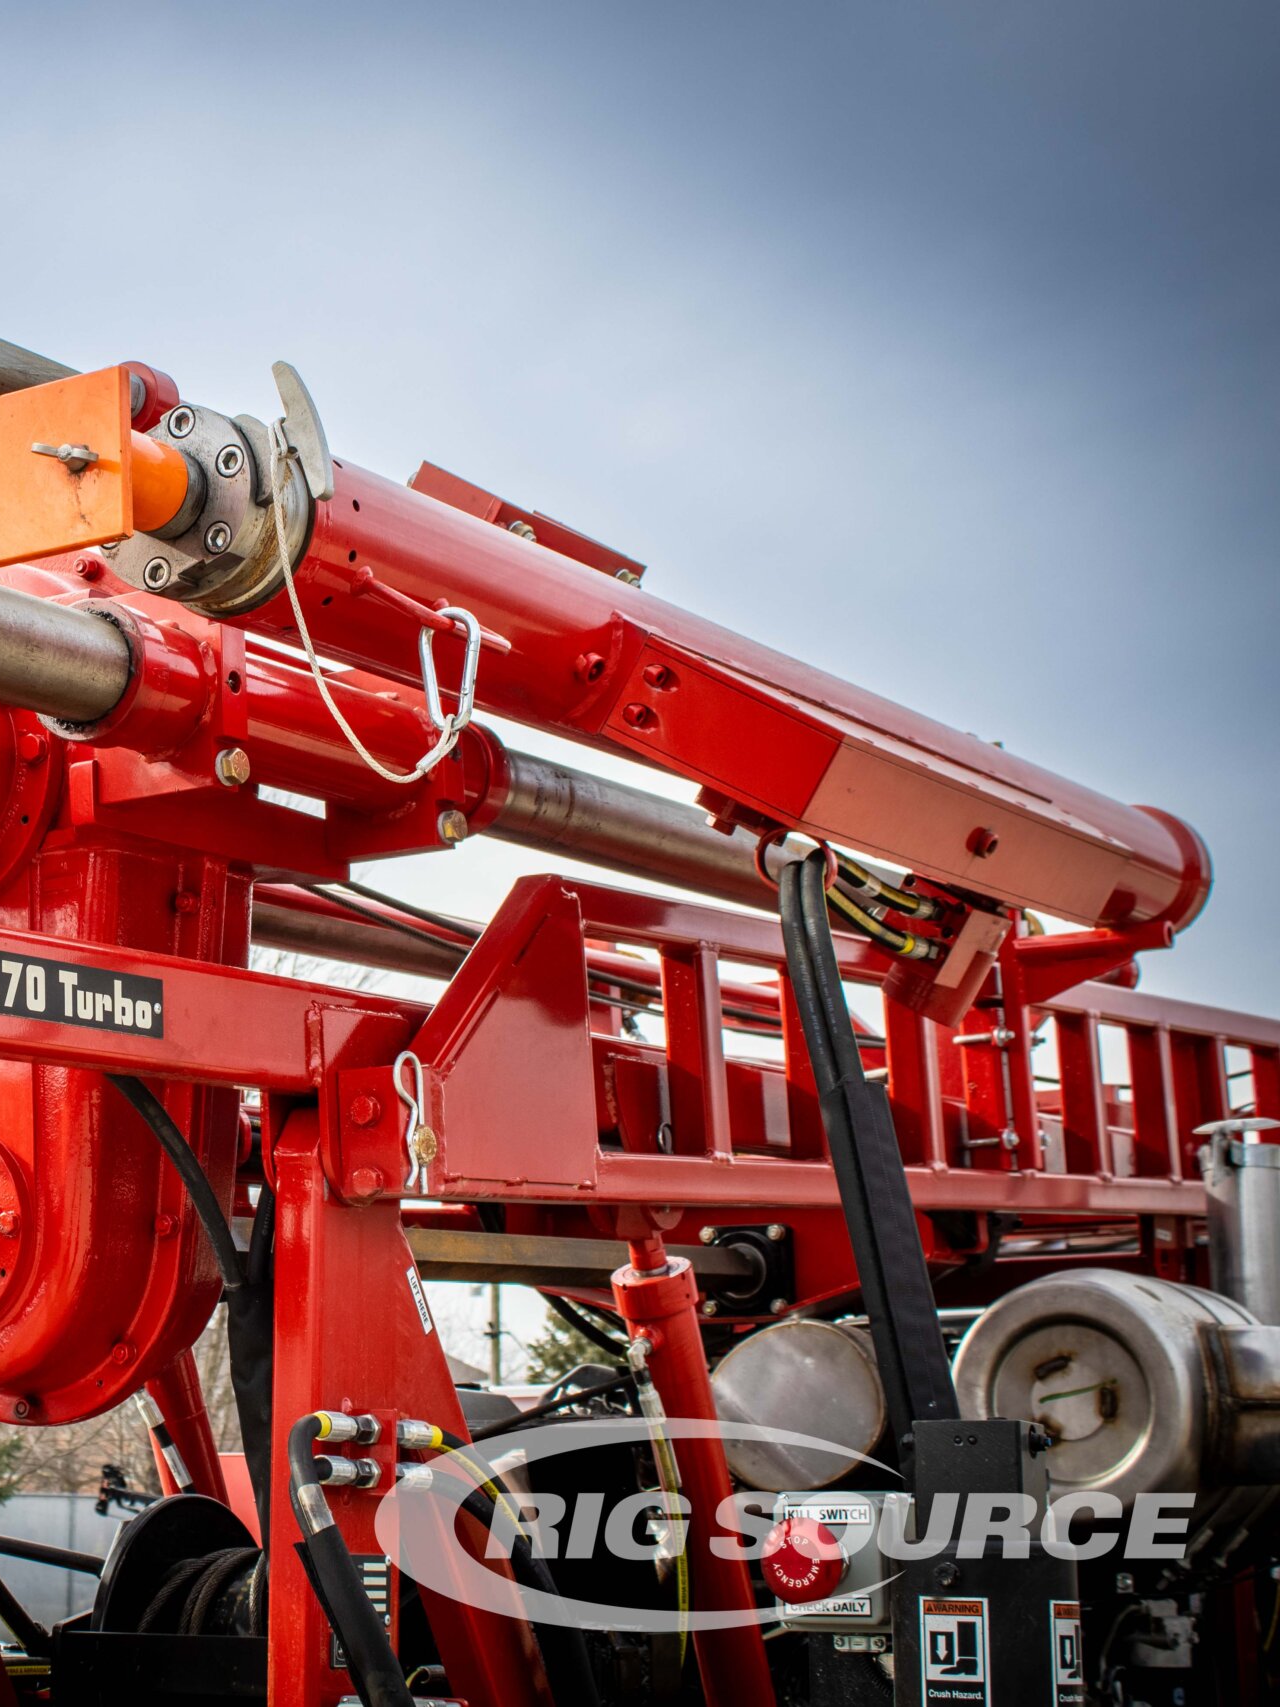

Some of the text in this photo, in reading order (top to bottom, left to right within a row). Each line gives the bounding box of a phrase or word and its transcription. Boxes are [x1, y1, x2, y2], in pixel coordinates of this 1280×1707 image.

[58, 969, 153, 1031] Turbo
[410, 1275, 428, 1325] LIFT HERE
[787, 1509, 867, 1520] KILL SWITCH
[779, 1536, 809, 1549] STOP
[773, 1558, 820, 1588] EMERGENCY
[790, 1602, 867, 1612] CHECK DAILY
[933, 1603, 980, 1614] WARNING
[928, 1689, 984, 1700] Crush Hazard.
